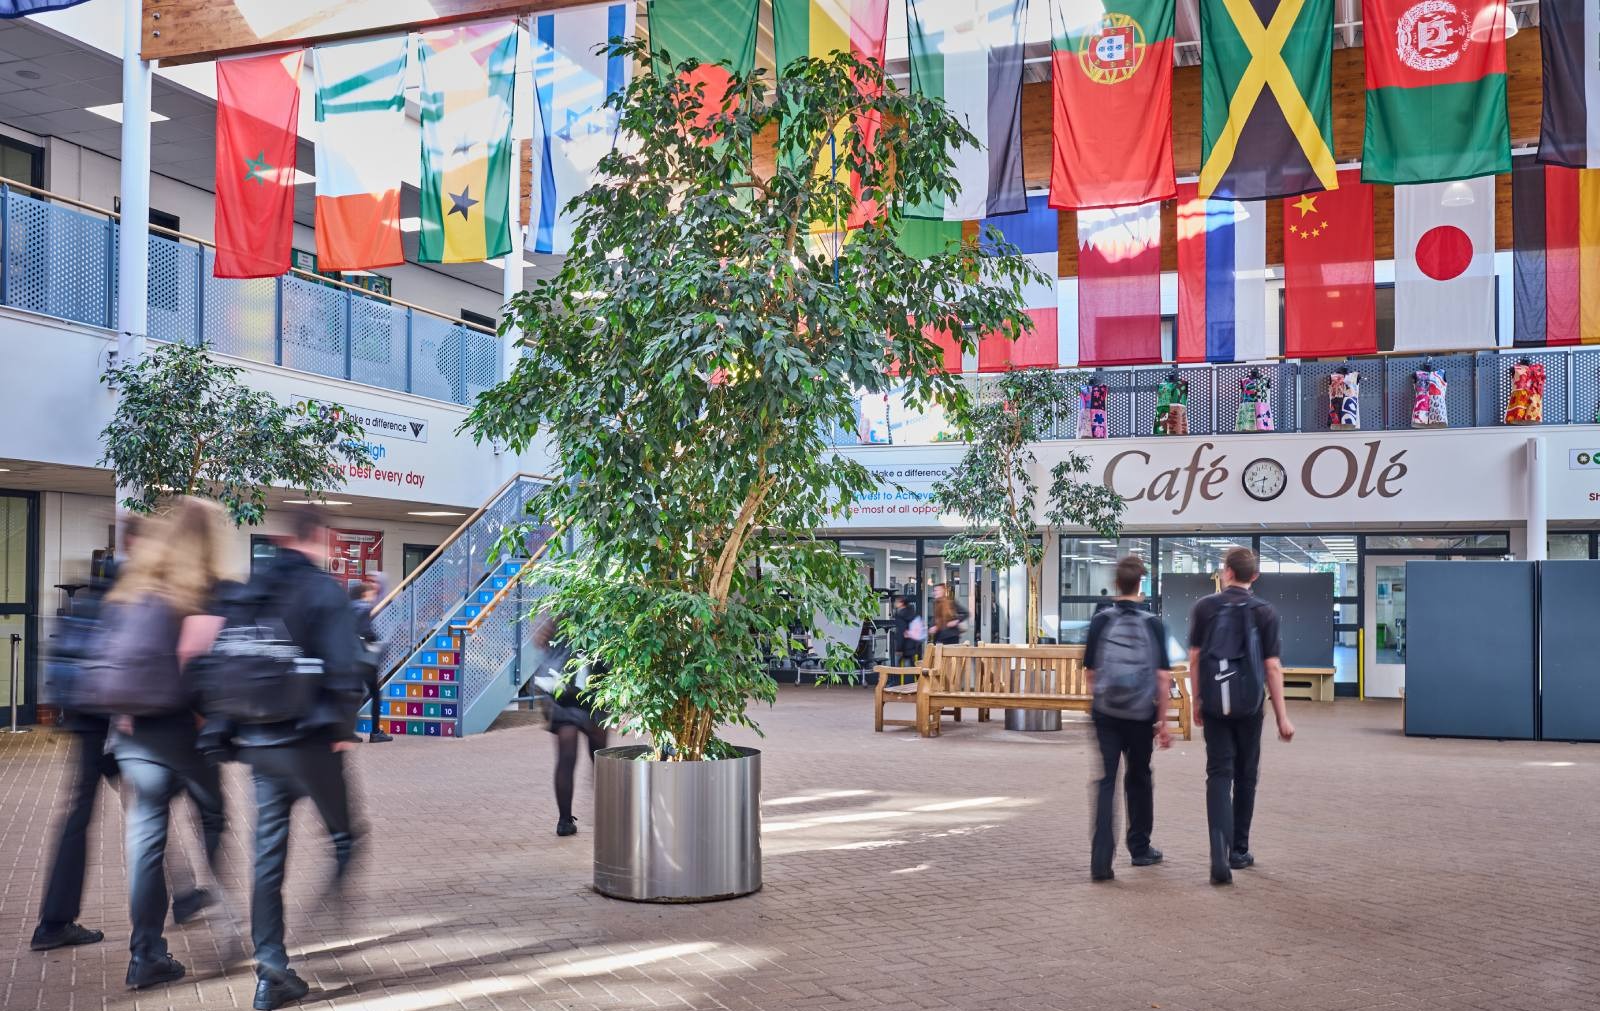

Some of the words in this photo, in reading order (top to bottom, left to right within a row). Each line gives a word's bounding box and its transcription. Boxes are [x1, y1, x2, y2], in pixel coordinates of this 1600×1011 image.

[364, 417, 371, 426] a
[372, 417, 407, 432] difference
[349, 462, 372, 480] best
[374, 468, 403, 486] every
[406, 471, 425, 489] day
[904, 468, 948, 478] difference
[1102, 442, 1229, 515] Café
[1300, 440, 1409, 499] Olé
[884, 491, 893, 501] to
[862, 505, 885, 515] most
[886, 504, 897, 514] of
[898, 504, 910, 514] all
